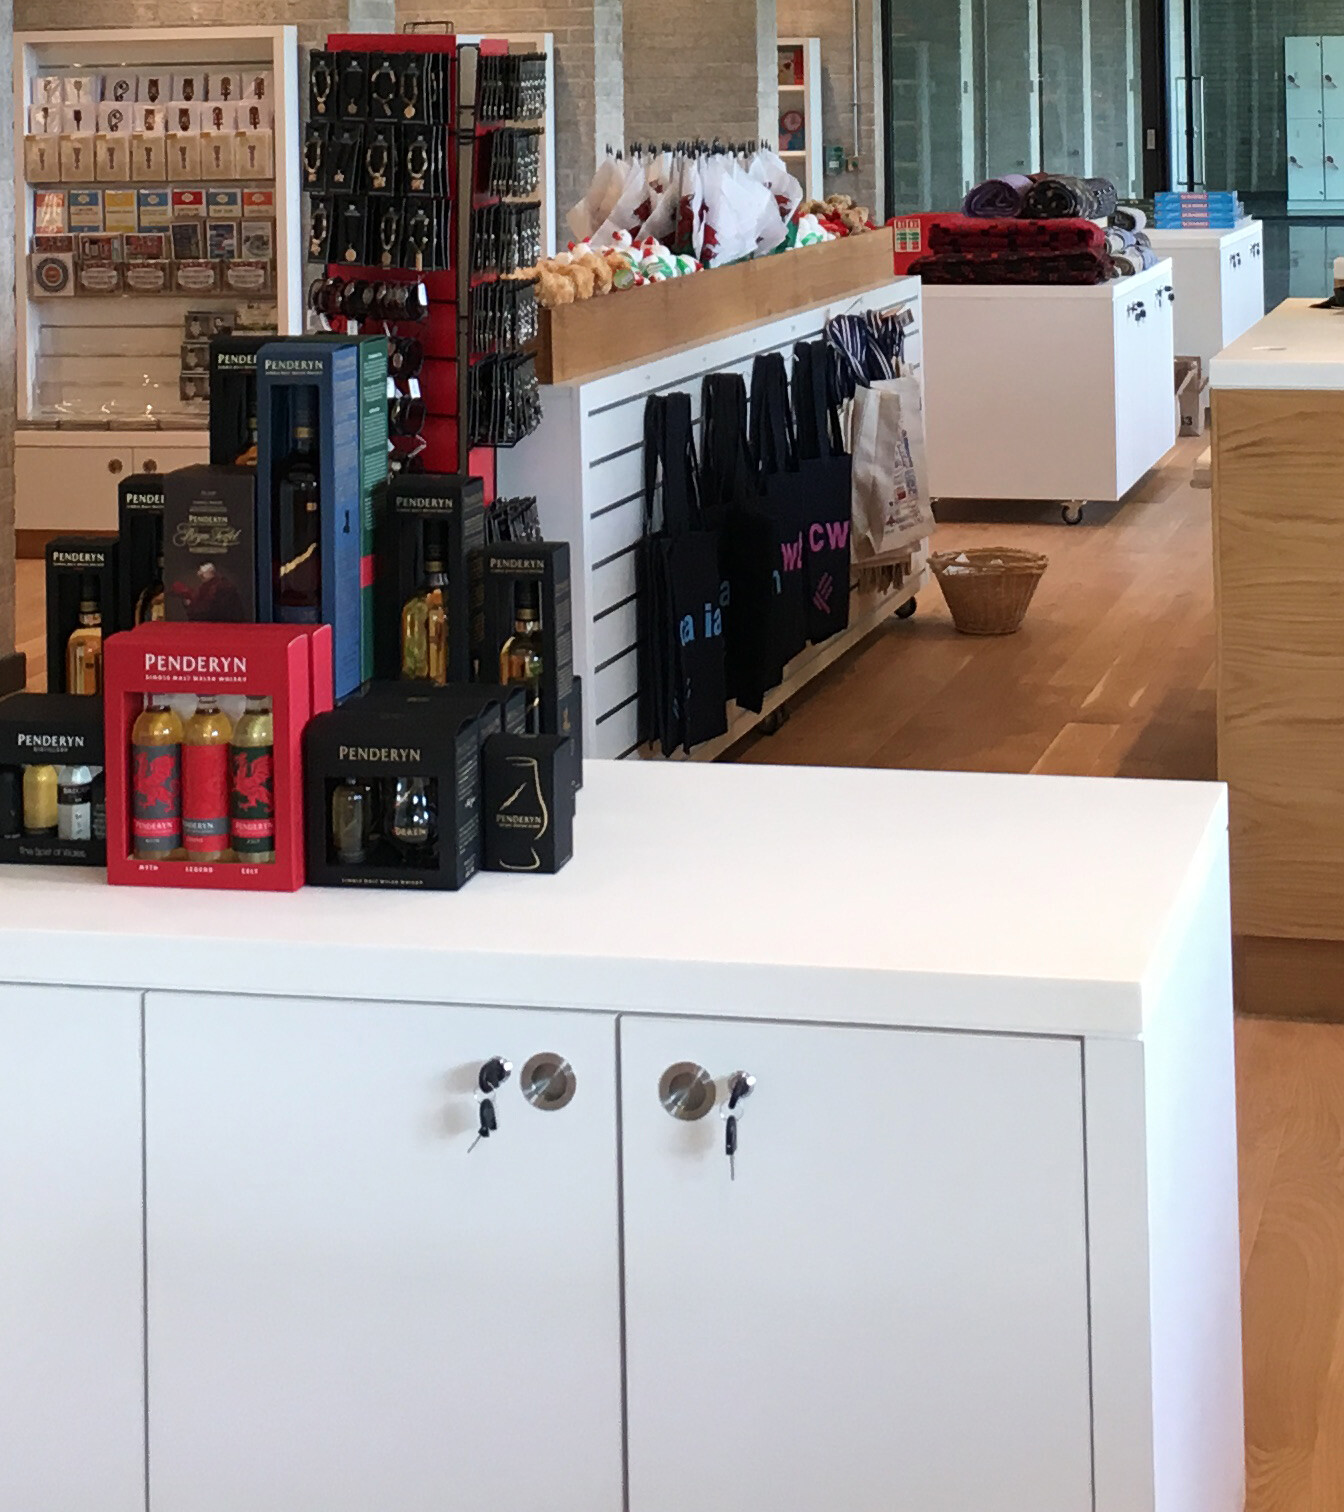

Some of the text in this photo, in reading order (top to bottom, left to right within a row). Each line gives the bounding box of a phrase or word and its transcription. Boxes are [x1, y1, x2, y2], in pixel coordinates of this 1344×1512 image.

[217, 353, 257, 364] PENDE
[264, 359, 324, 370] PENDERYN
[126, 493, 165, 504] PENDE
[396, 496, 453, 508] PENDERYN
[52, 551, 105, 562] PENDERYN
[490, 557, 545, 568] PENDERYN
[144, 653, 248, 673] PENDERYN
[17, 733, 85, 747] PENDERYN
[339, 745, 421, 762] PENDERYN
[495, 814, 542, 824] PENDERYN
